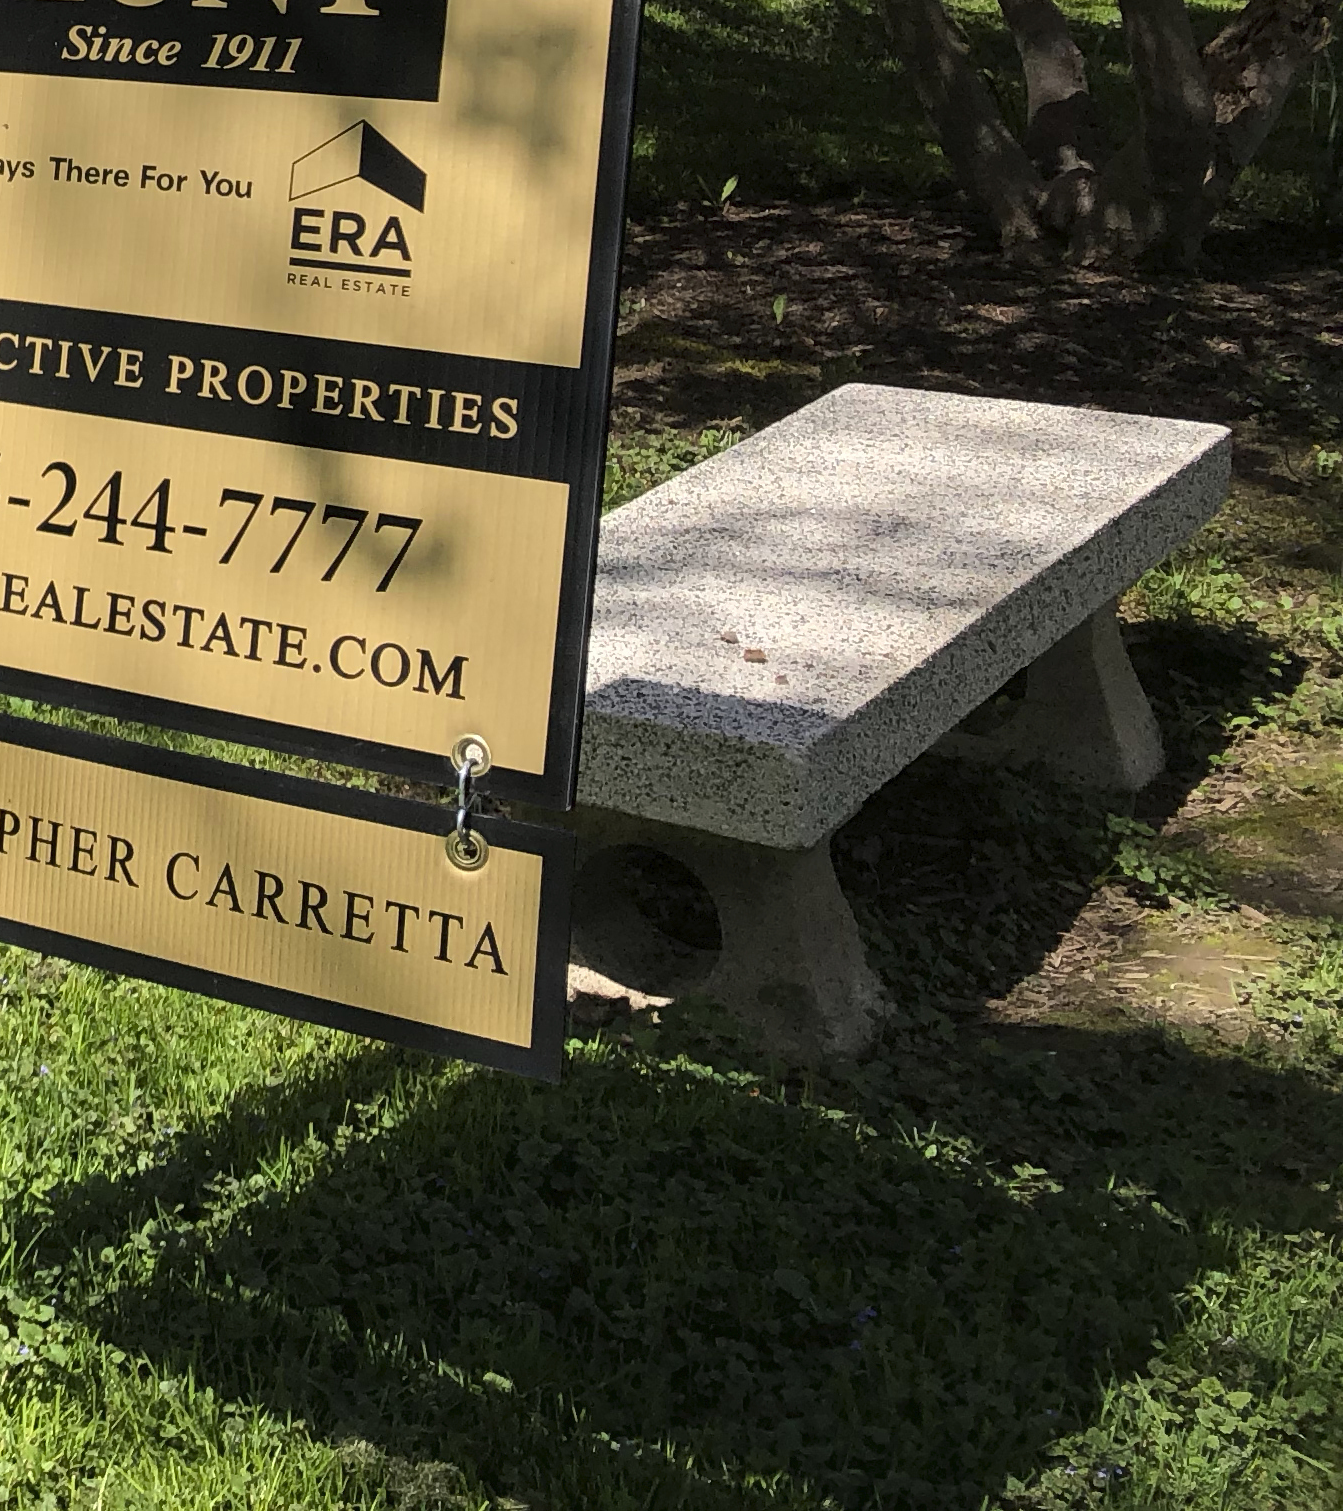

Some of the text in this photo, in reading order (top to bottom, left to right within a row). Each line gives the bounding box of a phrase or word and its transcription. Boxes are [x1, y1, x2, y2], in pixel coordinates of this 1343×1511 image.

[61, 25, 304, 75] Since 1911
[49, 155, 131, 189] There
[140, 163, 189, 194] For
[199, 169, 254, 200] You
[289, 208, 413, 263] ERA
[287, 272, 413, 298] REAL ESTATE
[167, 355, 520, 439] PROPERTIES
[166, 851, 512, 977] CARRETTA
